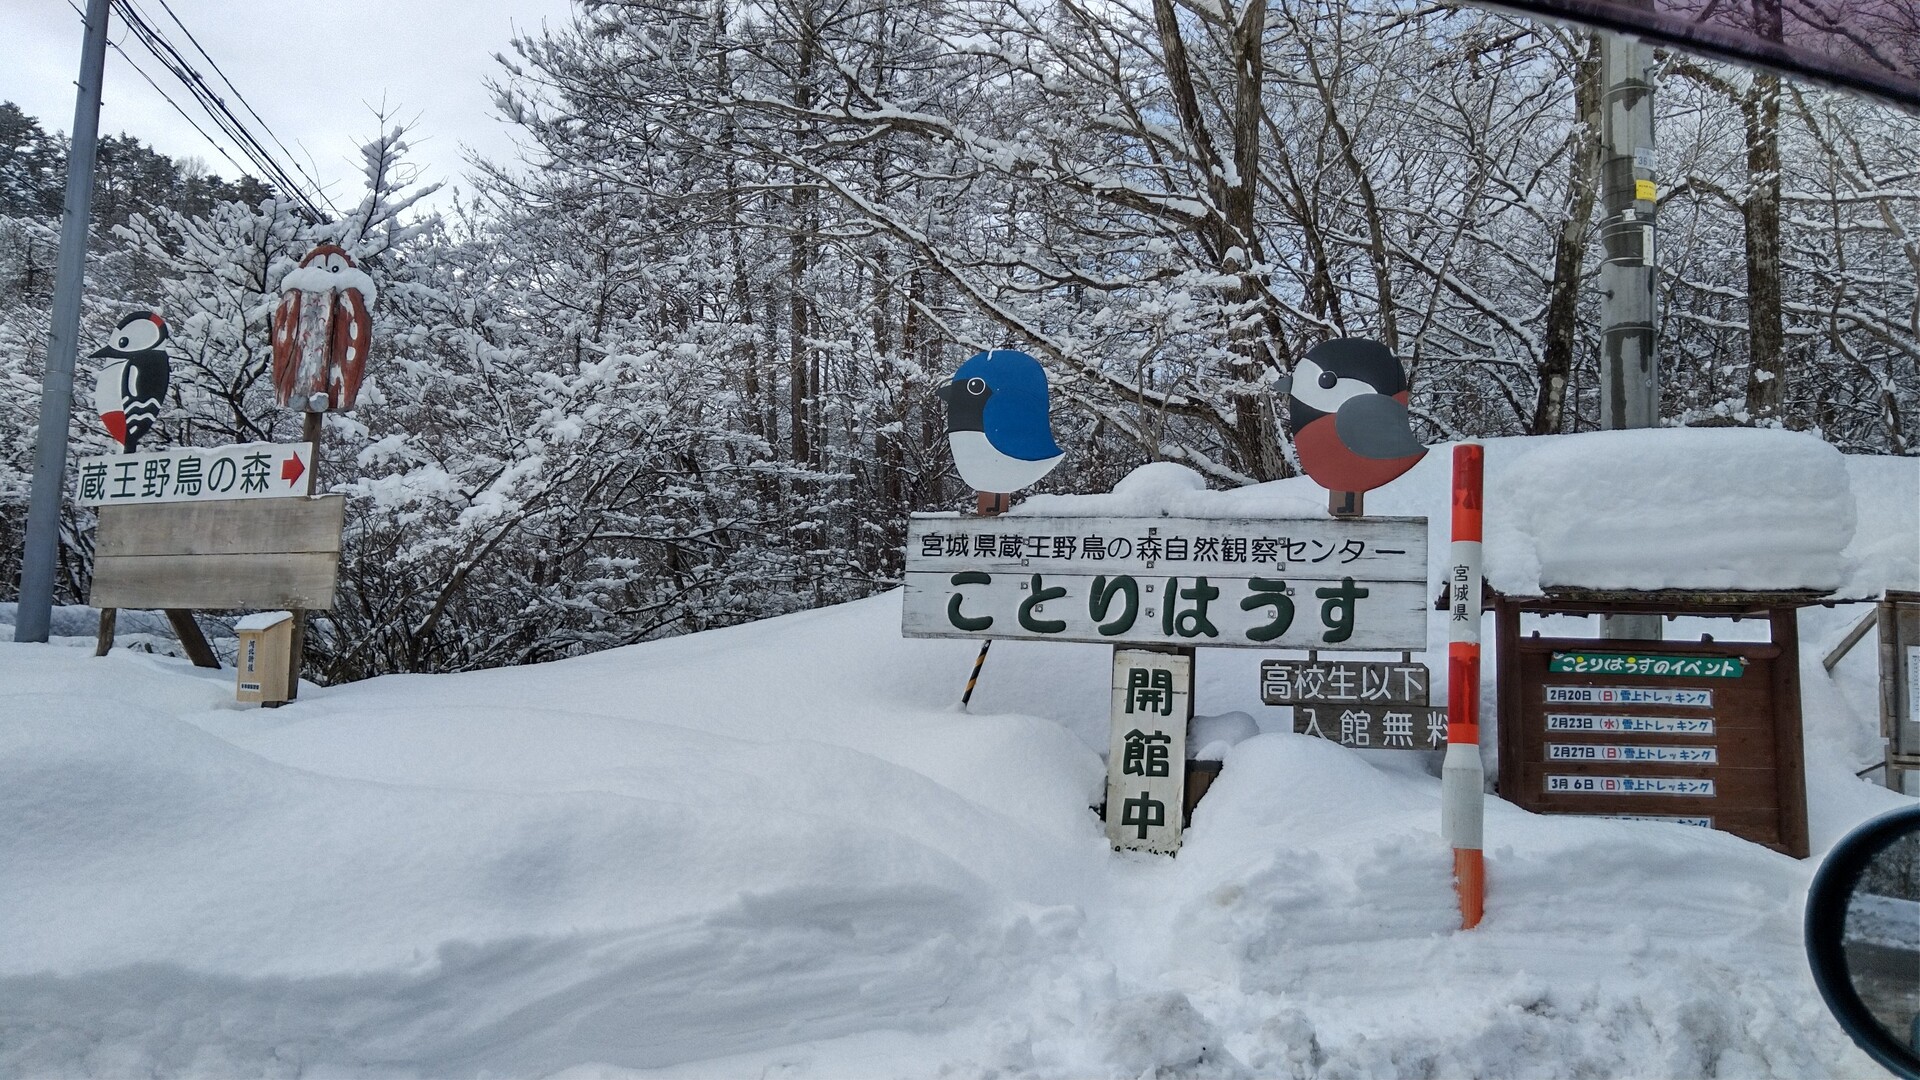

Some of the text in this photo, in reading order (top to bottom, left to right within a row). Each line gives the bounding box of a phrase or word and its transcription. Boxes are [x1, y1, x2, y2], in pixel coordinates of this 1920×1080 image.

[78, 451, 272, 501] 蔵王野鳥の森
[921, 533, 1406, 563] 宮城県蔵王野鳥の森自然観察センター
[946, 570, 1370, 643] ことりはうす
[1453, 564, 1470, 621] 宮城県
[1261, 663, 1425, 702] 高校生以下
[1562, 655, 1735, 677] ことりはうすのイベント
[1302, 708, 1449, 750] 入館無料
[1121, 667, 1174, 840] 開館中
